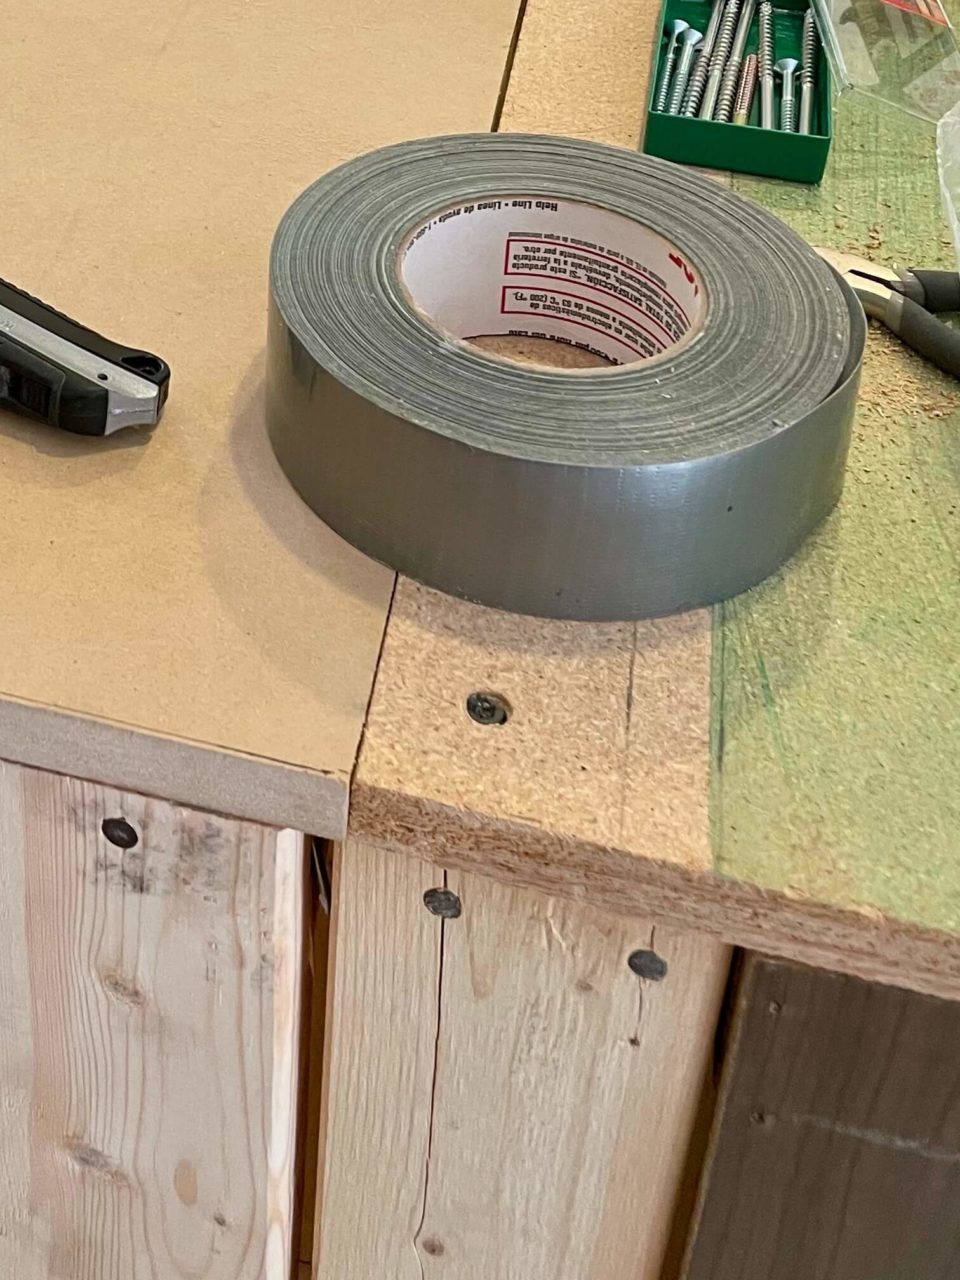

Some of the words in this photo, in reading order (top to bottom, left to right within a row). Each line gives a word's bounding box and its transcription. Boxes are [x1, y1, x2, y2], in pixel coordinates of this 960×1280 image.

[477, 201, 502, 211] Línea
[512, 200, 532, 209] Line
[536, 201, 558, 211] Help
[463, 205, 474, 214] de
[544, 247, 556, 255] por
[554, 258, 561, 266] la
[512, 263, 547, 271] producto
[550, 266, 567, 275] este
[574, 302, 583, 311] de
[645, 303, 664, 324] TOTAL
